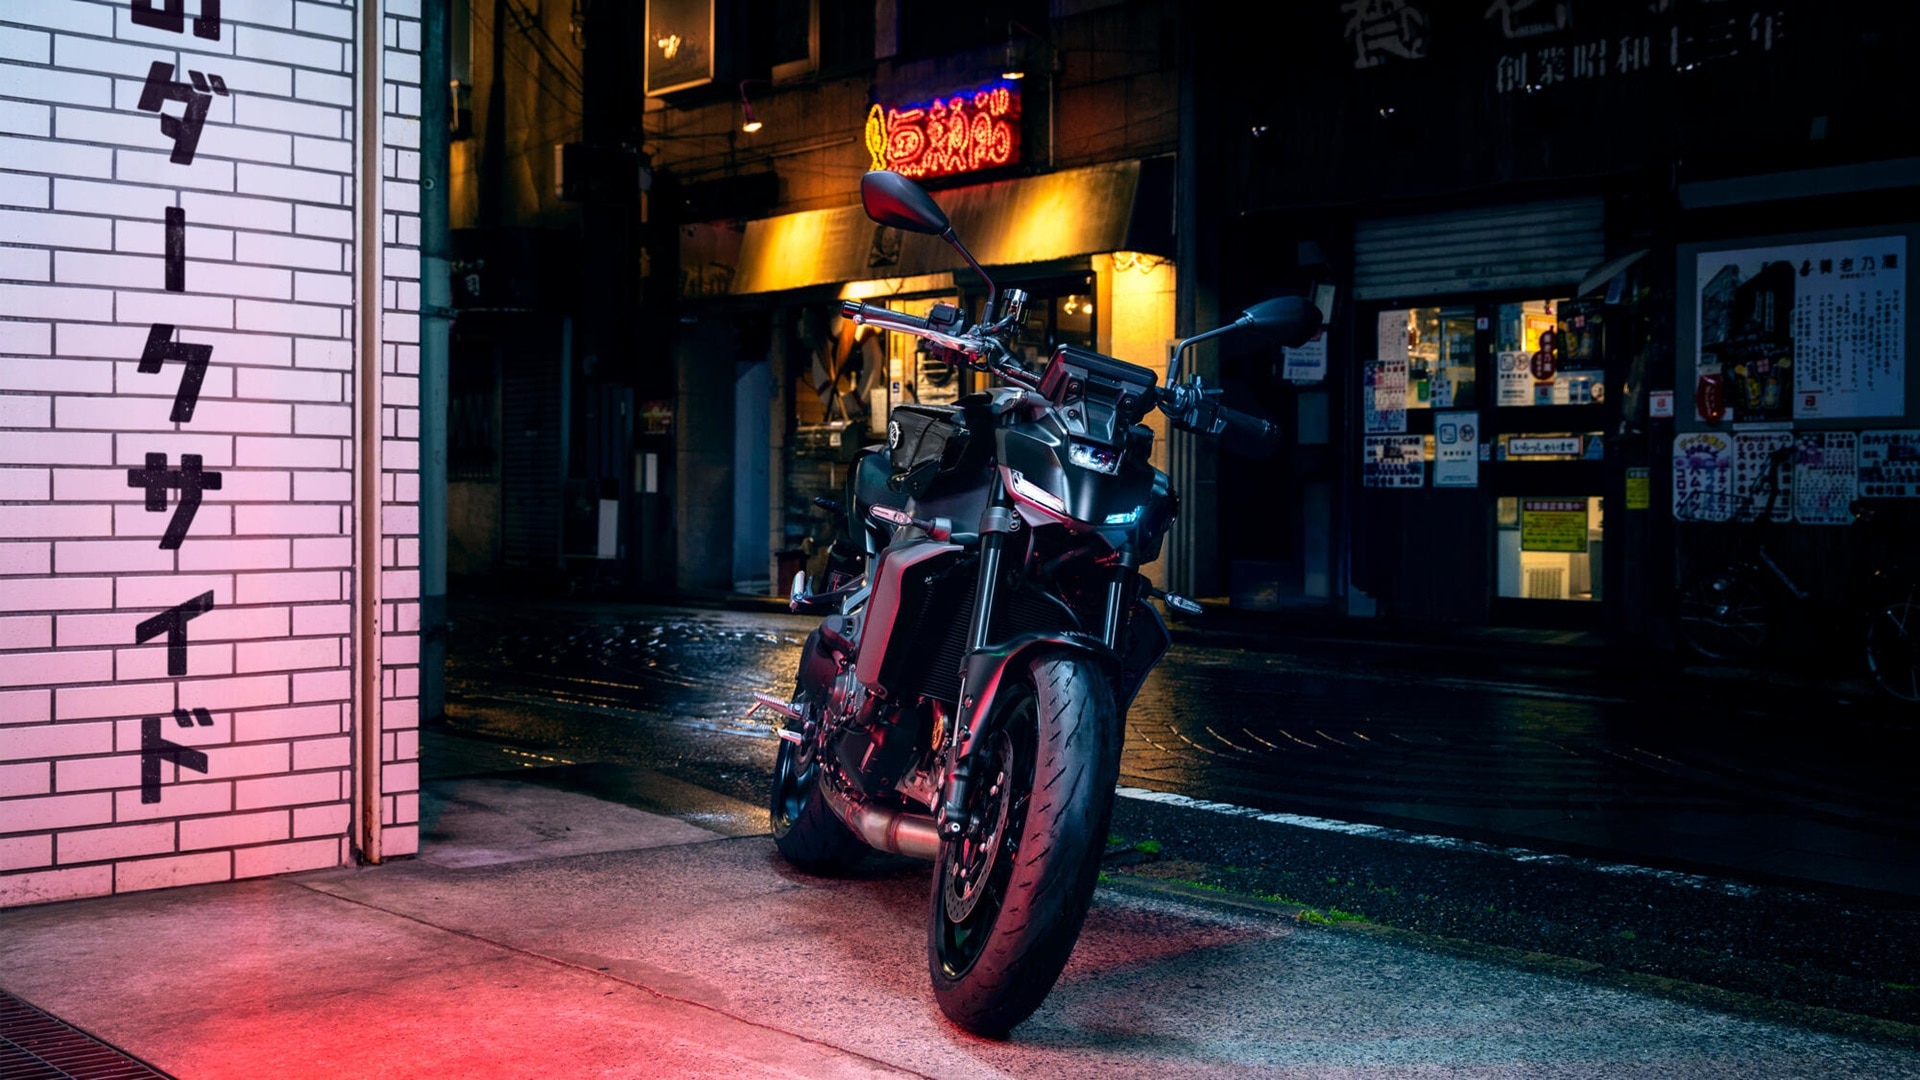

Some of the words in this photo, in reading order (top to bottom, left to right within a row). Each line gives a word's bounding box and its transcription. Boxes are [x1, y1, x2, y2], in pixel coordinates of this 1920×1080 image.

[1495, 10, 1785, 94] 創業昭和十三年
[1513, 441, 1575, 453] いらっしゃいませ
